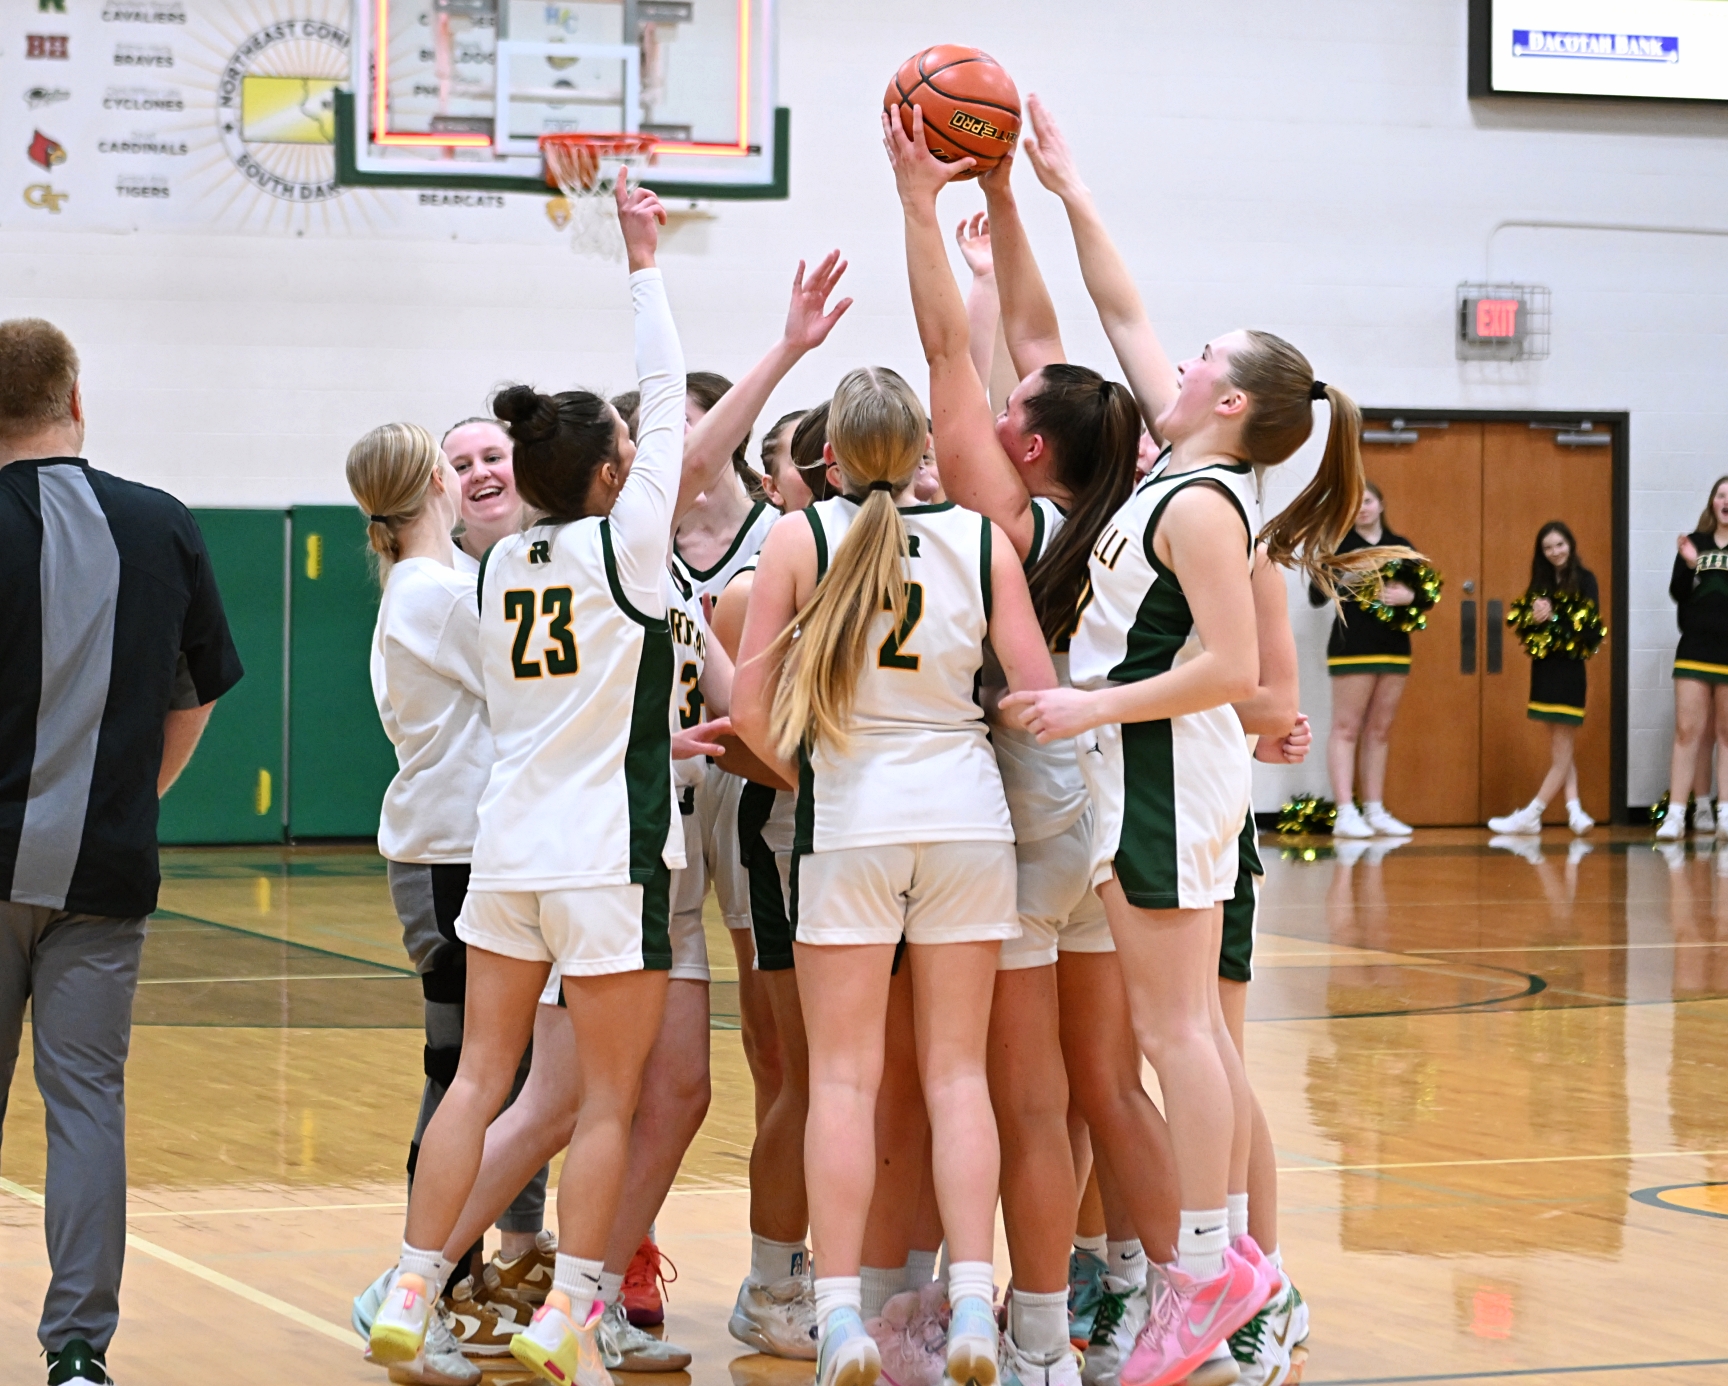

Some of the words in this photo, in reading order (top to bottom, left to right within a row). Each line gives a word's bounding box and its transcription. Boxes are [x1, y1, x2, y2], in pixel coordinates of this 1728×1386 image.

[101, 10, 188, 25] CAVALIERS
[1528, 31, 1612, 54] DACOTAH
[1614, 34, 1664, 56] BANK
[113, 55, 174, 69] BRAVES
[220, 22, 296, 108] NORTHEAST
[102, 98, 184, 113] CYCLONES
[98, 142, 188, 156] CARDINALS
[236, 154, 295, 199] SOUTH
[115, 186, 170, 199] TIGERS
[418, 193, 505, 208] BEARCATS
[1476, 299, 1519, 337] EXIT
[503, 584, 581, 681] 23
[876, 580, 926, 673] 2
